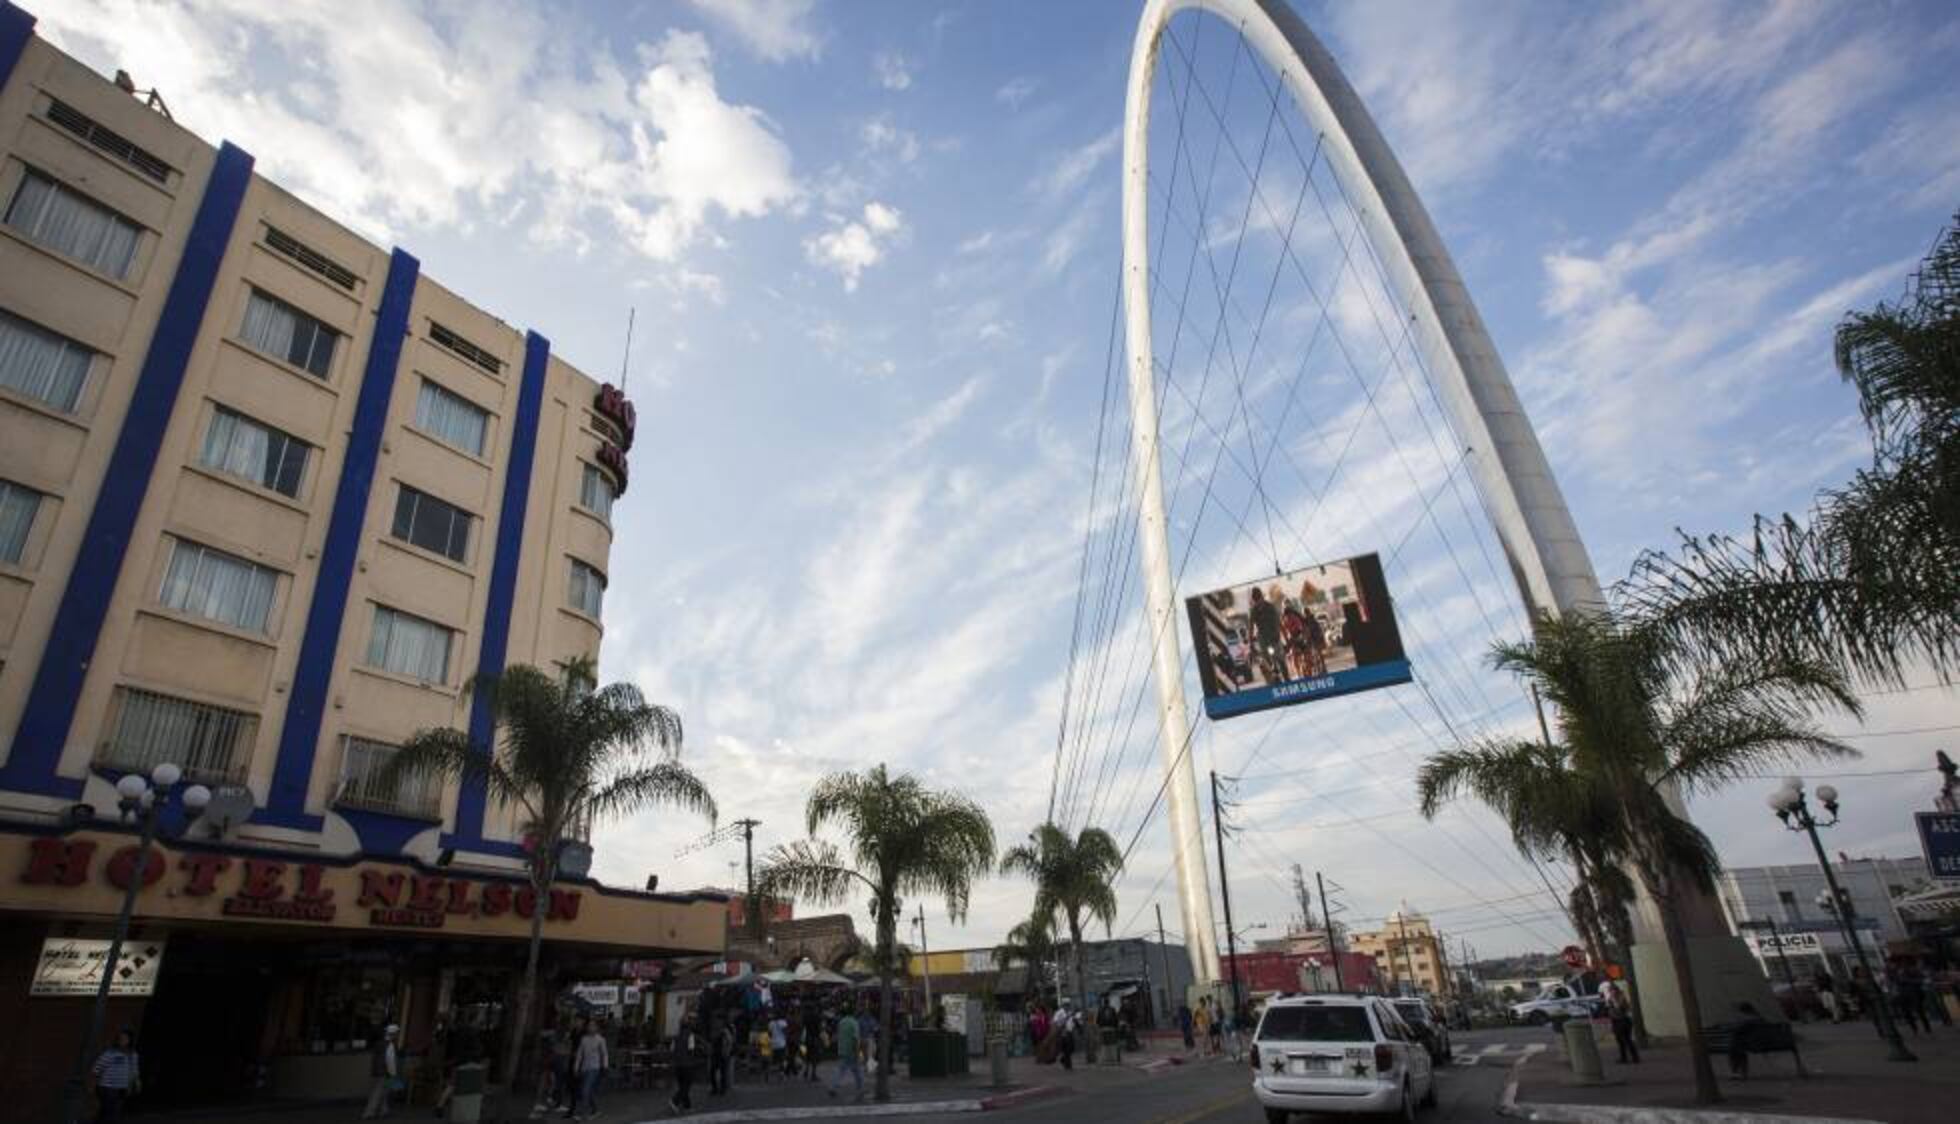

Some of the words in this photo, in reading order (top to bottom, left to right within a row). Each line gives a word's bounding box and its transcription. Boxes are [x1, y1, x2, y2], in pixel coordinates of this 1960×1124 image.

[1272, 677, 1335, 698] SAMSUNG
[20, 836, 334, 902] HOTEL
[357, 869, 582, 922] NELSON
[1758, 935, 1817, 947] POLICIA
[45, 949, 80, 960] HOTEL
